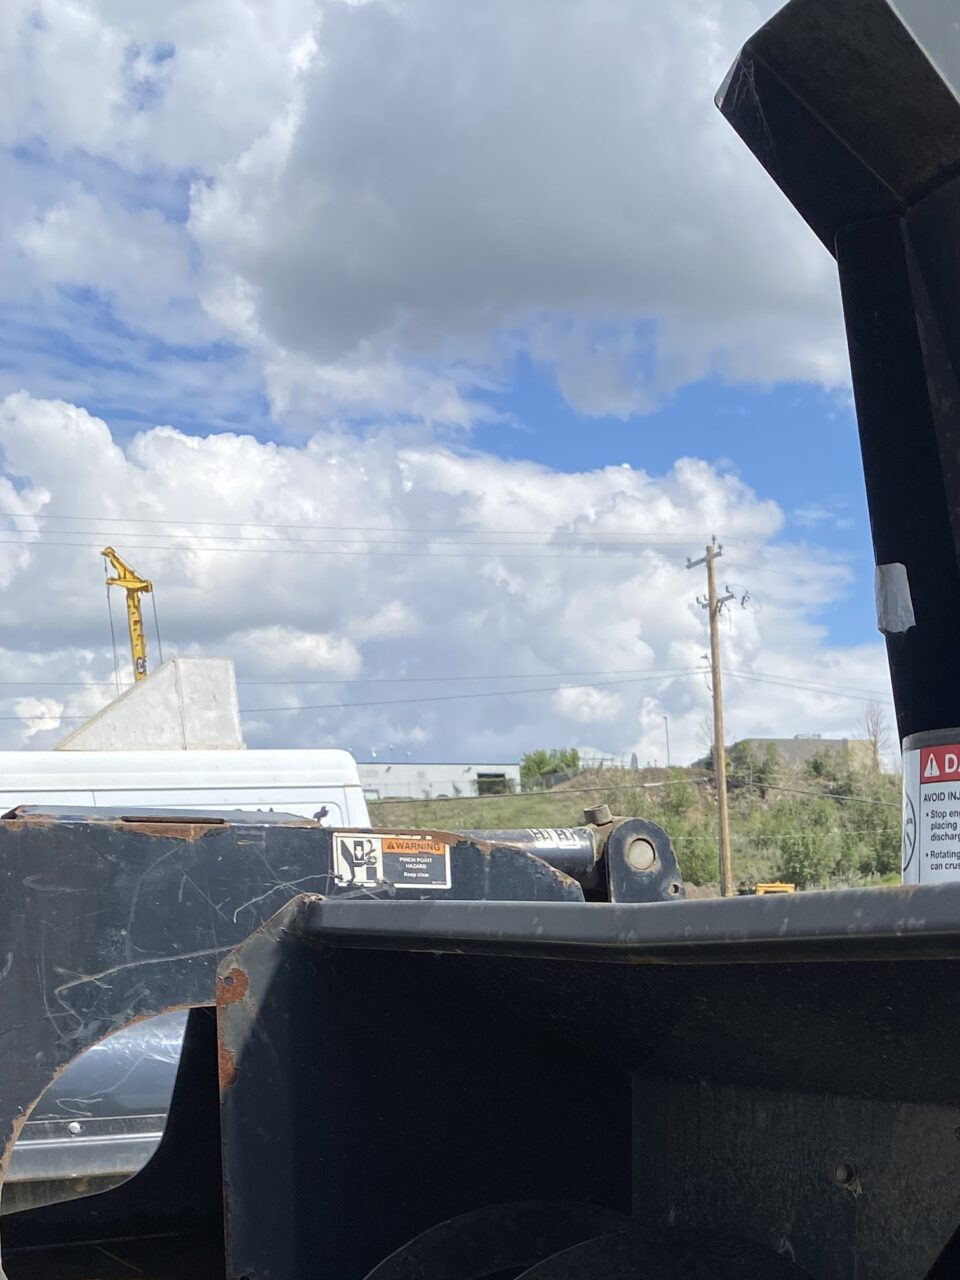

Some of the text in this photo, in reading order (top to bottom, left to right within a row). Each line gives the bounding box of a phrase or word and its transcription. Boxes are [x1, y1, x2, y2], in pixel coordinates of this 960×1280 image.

[923, 792, 945, 802] AVOID
[930, 809, 947, 819] Stop
[930, 820, 958, 831] placing
[395, 842, 440, 851] WARNING
